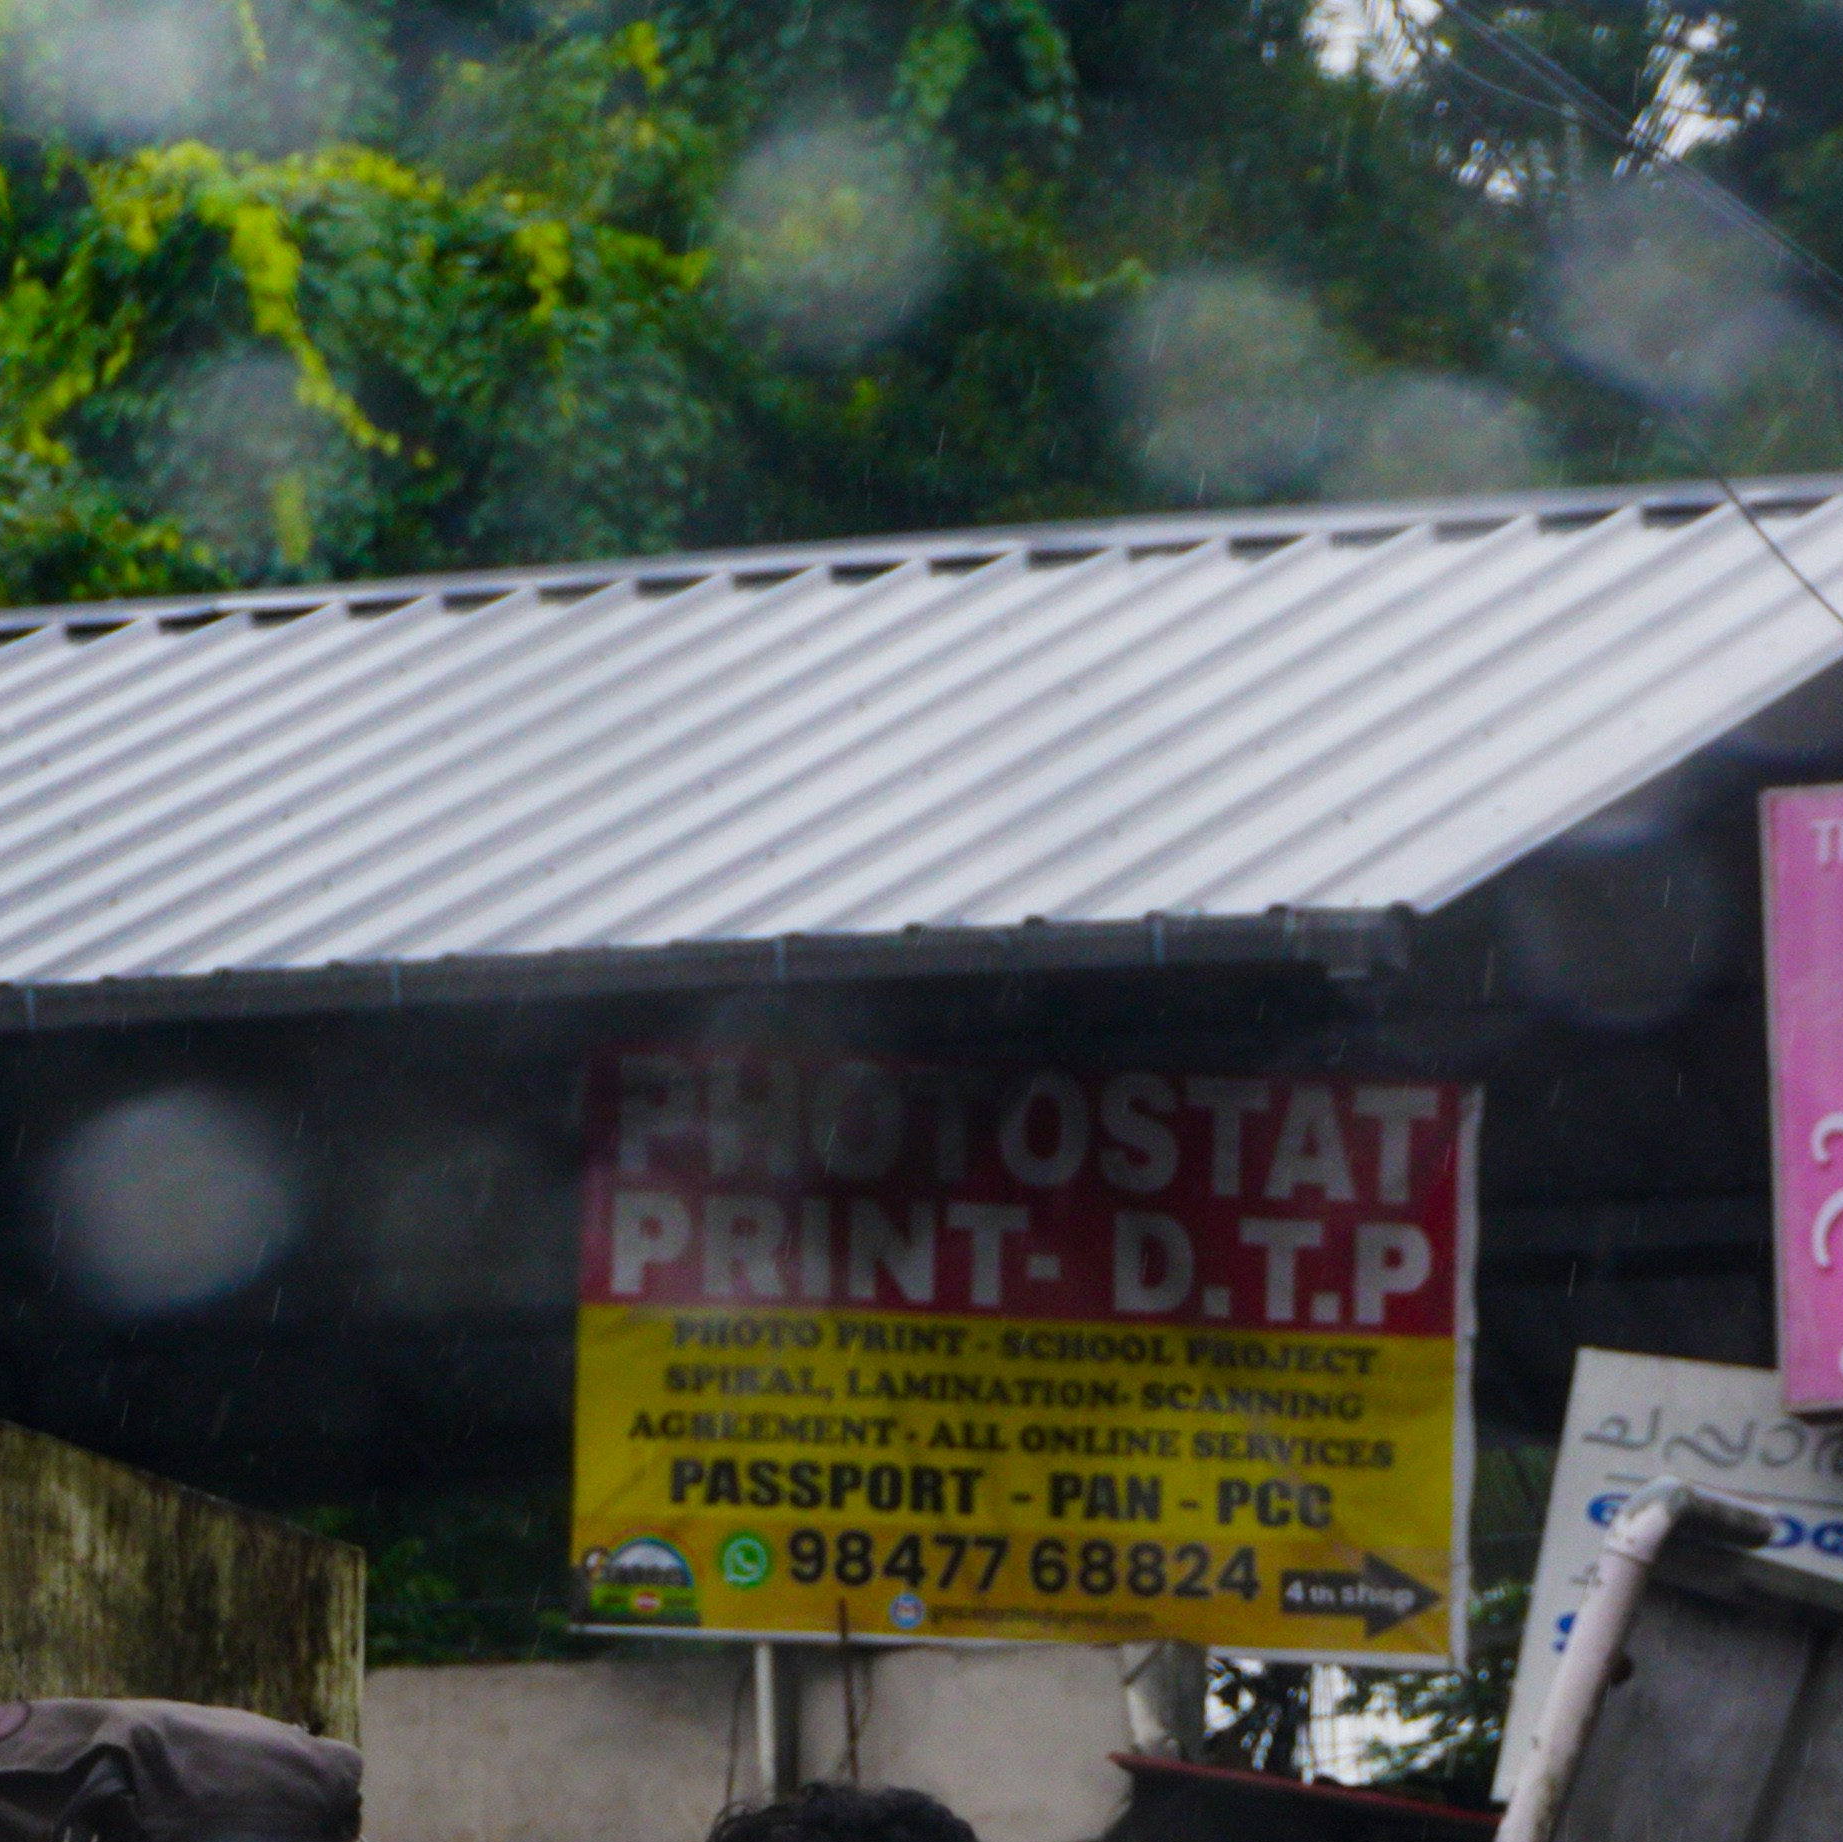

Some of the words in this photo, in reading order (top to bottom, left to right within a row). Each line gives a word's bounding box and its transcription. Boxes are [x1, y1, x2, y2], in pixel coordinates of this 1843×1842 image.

[617, 1054, 1440, 1206] PHOTOSTAT
[1113, 1210, 1432, 1324] D.T.P
[672, 1315, 822, 1349] PHOTO
[836, 1321, 966, 1356] PRINT
[1002, 1328, 1174, 1365] SCHOOL
[1185, 1336, 1379, 1375] PROJECT
[665, 1363, 833, 1400] SPIRAL,
[1141, 1382, 1364, 1420] SCANNING
[628, 1408, 897, 1446] AGREEMENT
[929, 1419, 1007, 1452] ALL
[1020, 1424, 1181, 1459] ONLINE
[1193, 1430, 1395, 1469] SERVICES
[671, 1456, 983, 1515] PASSPORT
[1049, 1471, 1163, 1523] PAN
[1217, 1477, 1333, 1529] PCC
[788, 1528, 1010, 1594] 98477
[1030, 1536, 1260, 1601] 68824
[1285, 1580, 1305, 1602] 4
[1341, 1580, 1417, 1614] shop
